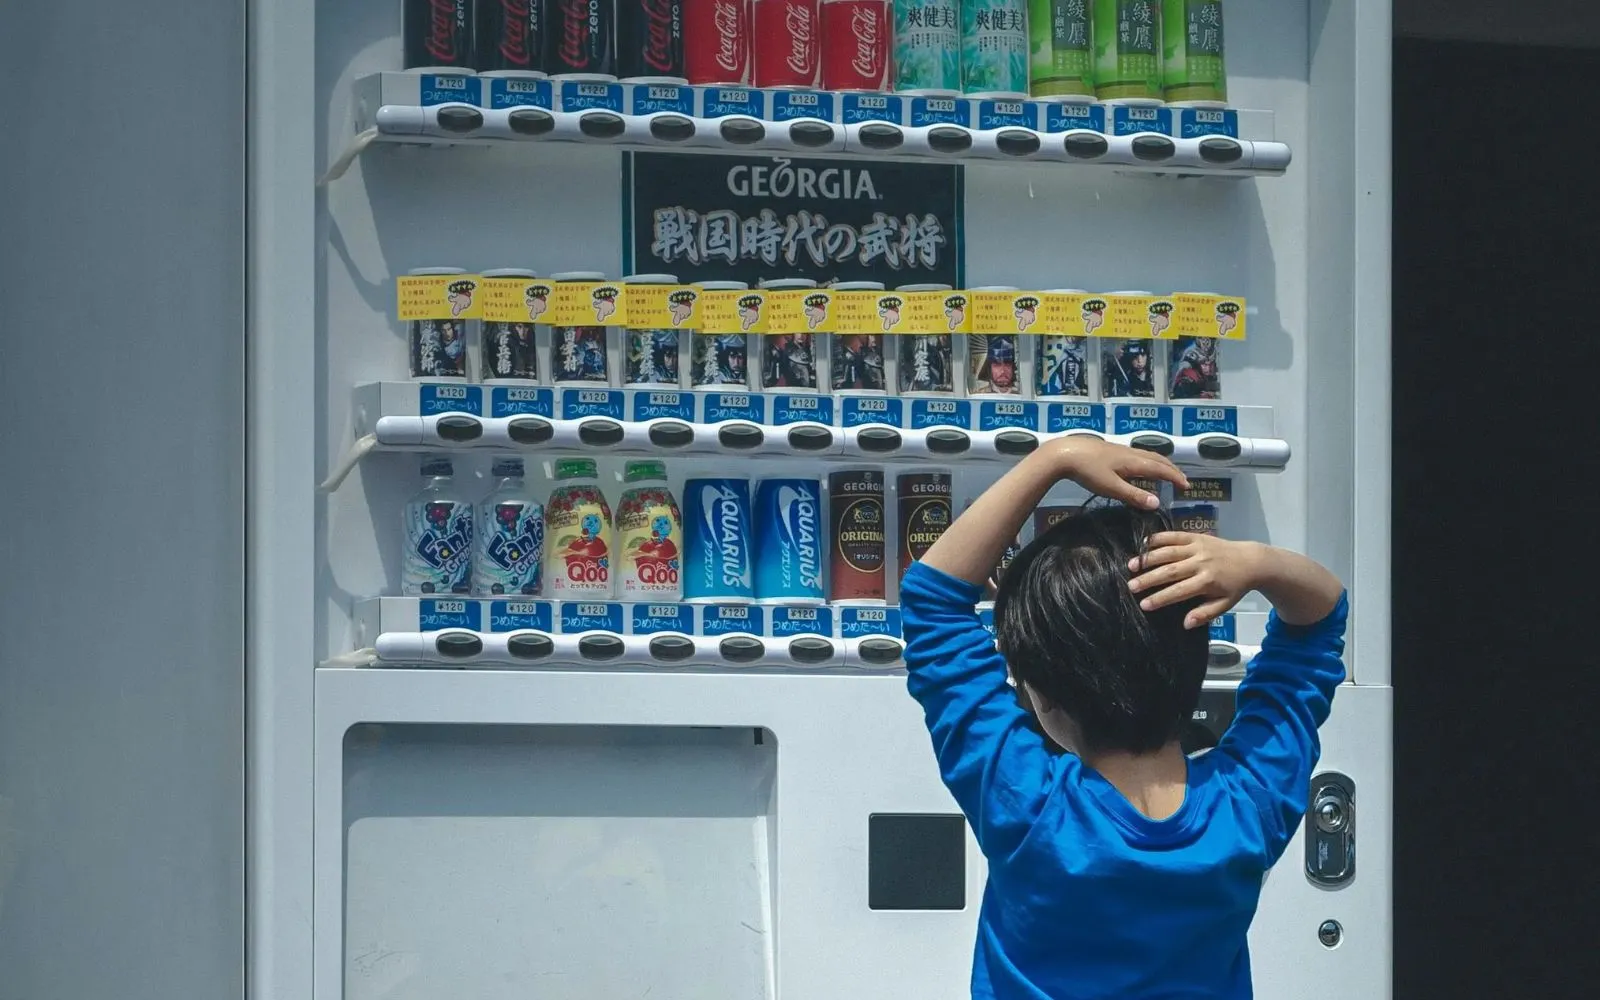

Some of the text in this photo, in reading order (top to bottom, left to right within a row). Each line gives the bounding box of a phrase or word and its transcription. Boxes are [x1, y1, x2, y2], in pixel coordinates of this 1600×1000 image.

[589, 0, 599, 33] zero
[672, 4, 680, 38] zero
[438, 78, 463, 88] ¥120
[510, 82, 534, 92] ¥120
[580, 85, 606, 95] ¥120
[652, 88, 676, 98] ¥120
[722, 91, 747, 101] ¥120
[792, 94, 817, 104] ¥120
[861, 98, 886, 108] ¥120
[929, 101, 954, 111] ¥120
[997, 104, 1022, 114] ¥120
[1064, 106, 1088, 116] ¥120
[1131, 109, 1156, 119] ¥120
[1198, 111, 1223, 121] ¥120
[727, 157, 877, 199] GEORGIA
[652, 206, 946, 269] 戦国時代の武将
[440, 388, 464, 398] ¥120
[510, 390, 536, 400] ¥120
[582, 392, 606, 402] ¥120
[652, 394, 678, 404] ¥120
[722, 396, 748, 406] ¥120
[792, 398, 817, 408] ¥120
[860, 400, 886, 410] ¥120
[930, 402, 955, 412] ¥120
[998, 404, 1023, 414] ¥120
[1065, 406, 1090, 416] ¥120
[1132, 408, 1158, 418] ¥120
[1200, 409, 1224, 419] ¥120
[843, 482, 884, 492] GEORGI
[720, 484, 741, 588] AQUARIUS
[797, 486, 816, 589] AQUARIUS
[841, 531, 885, 542] ORIGINA
[568, 562, 608, 583] Qoo
[638, 563, 678, 584] Qoo
[438, 602, 463, 612] ¥120
[509, 604, 534, 614] ¥120
[580, 605, 605, 615] ¥120
[651, 606, 676, 616] ¥120
[722, 608, 746, 618] ¥120
[791, 608, 816, 618] ¥120
[859, 610, 884, 620] ¥120
